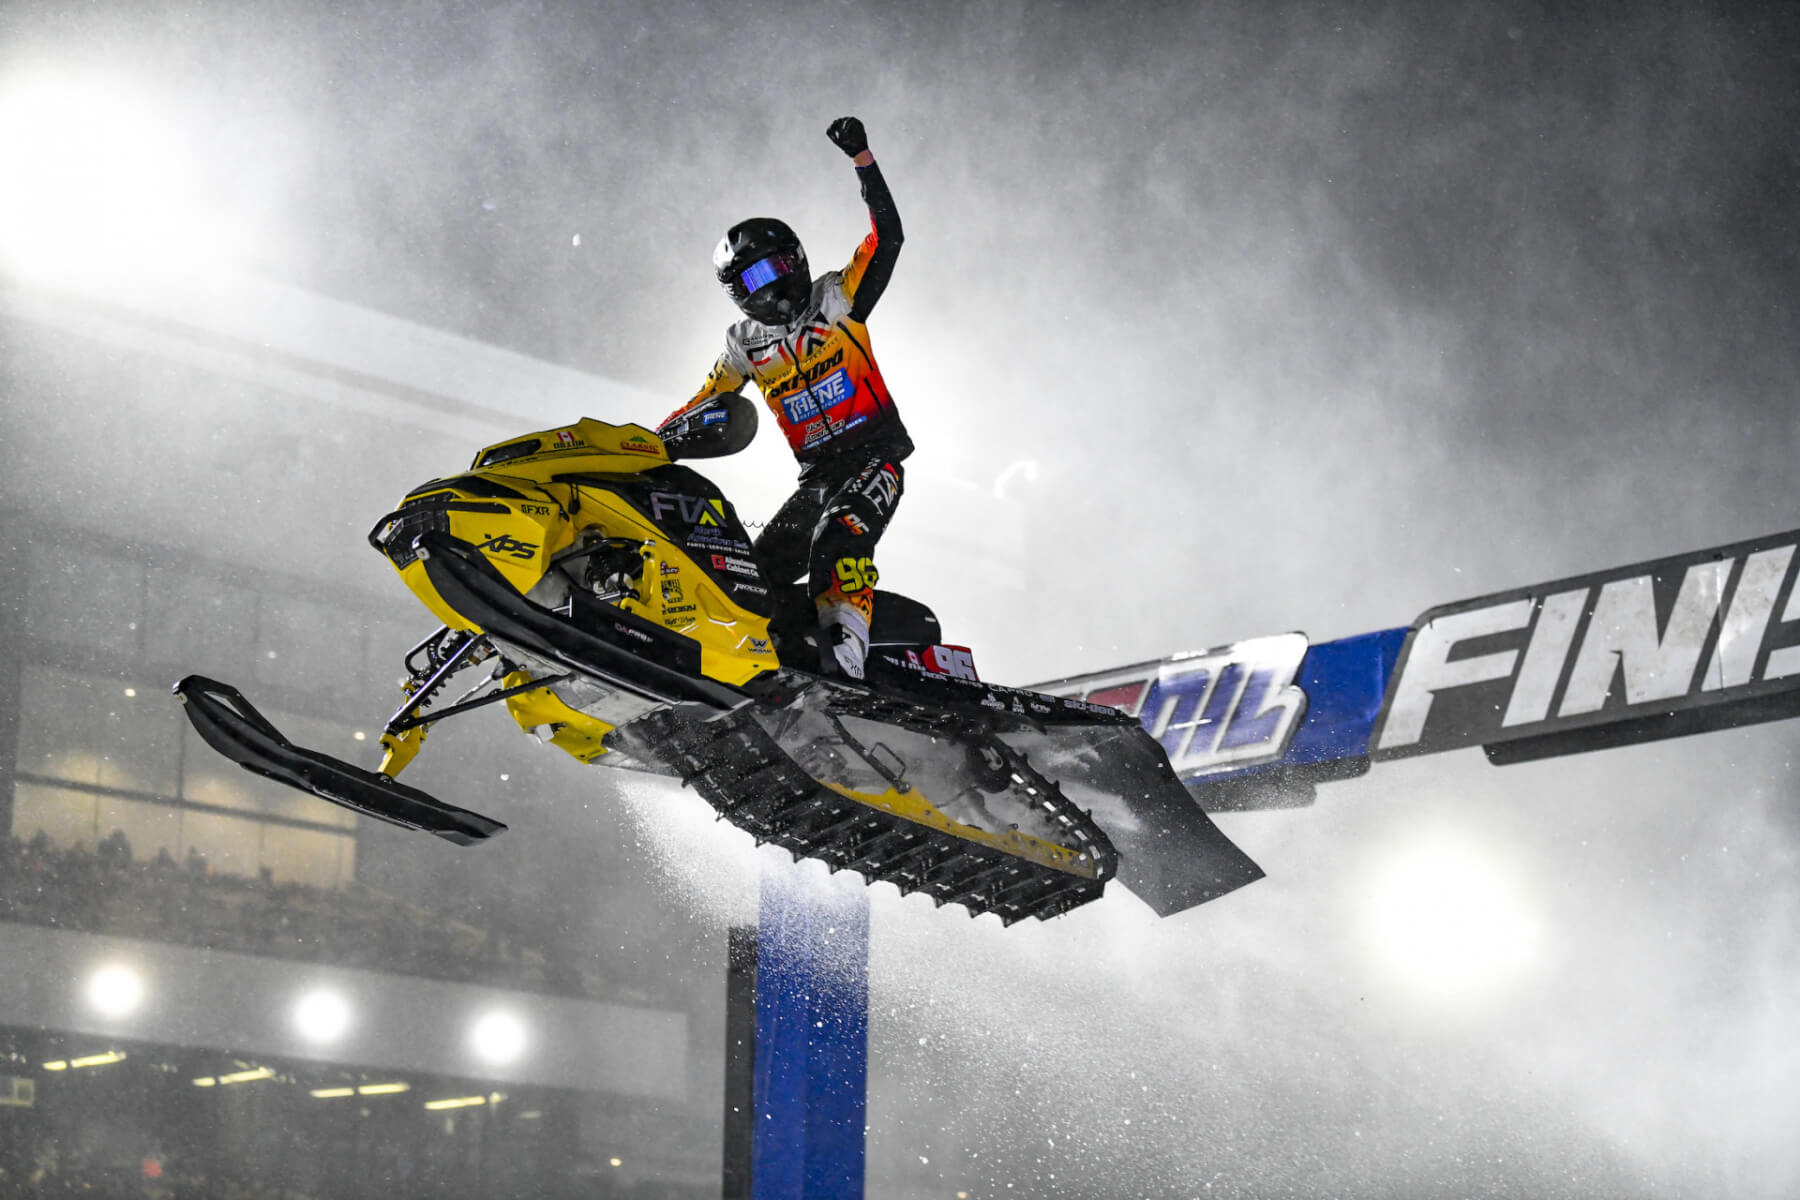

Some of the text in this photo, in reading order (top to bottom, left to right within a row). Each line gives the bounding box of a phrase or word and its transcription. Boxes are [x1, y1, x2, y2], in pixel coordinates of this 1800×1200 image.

[526, 505, 550, 516] FXR
[835, 557, 879, 593] 96
[933, 645, 977, 681] 96
